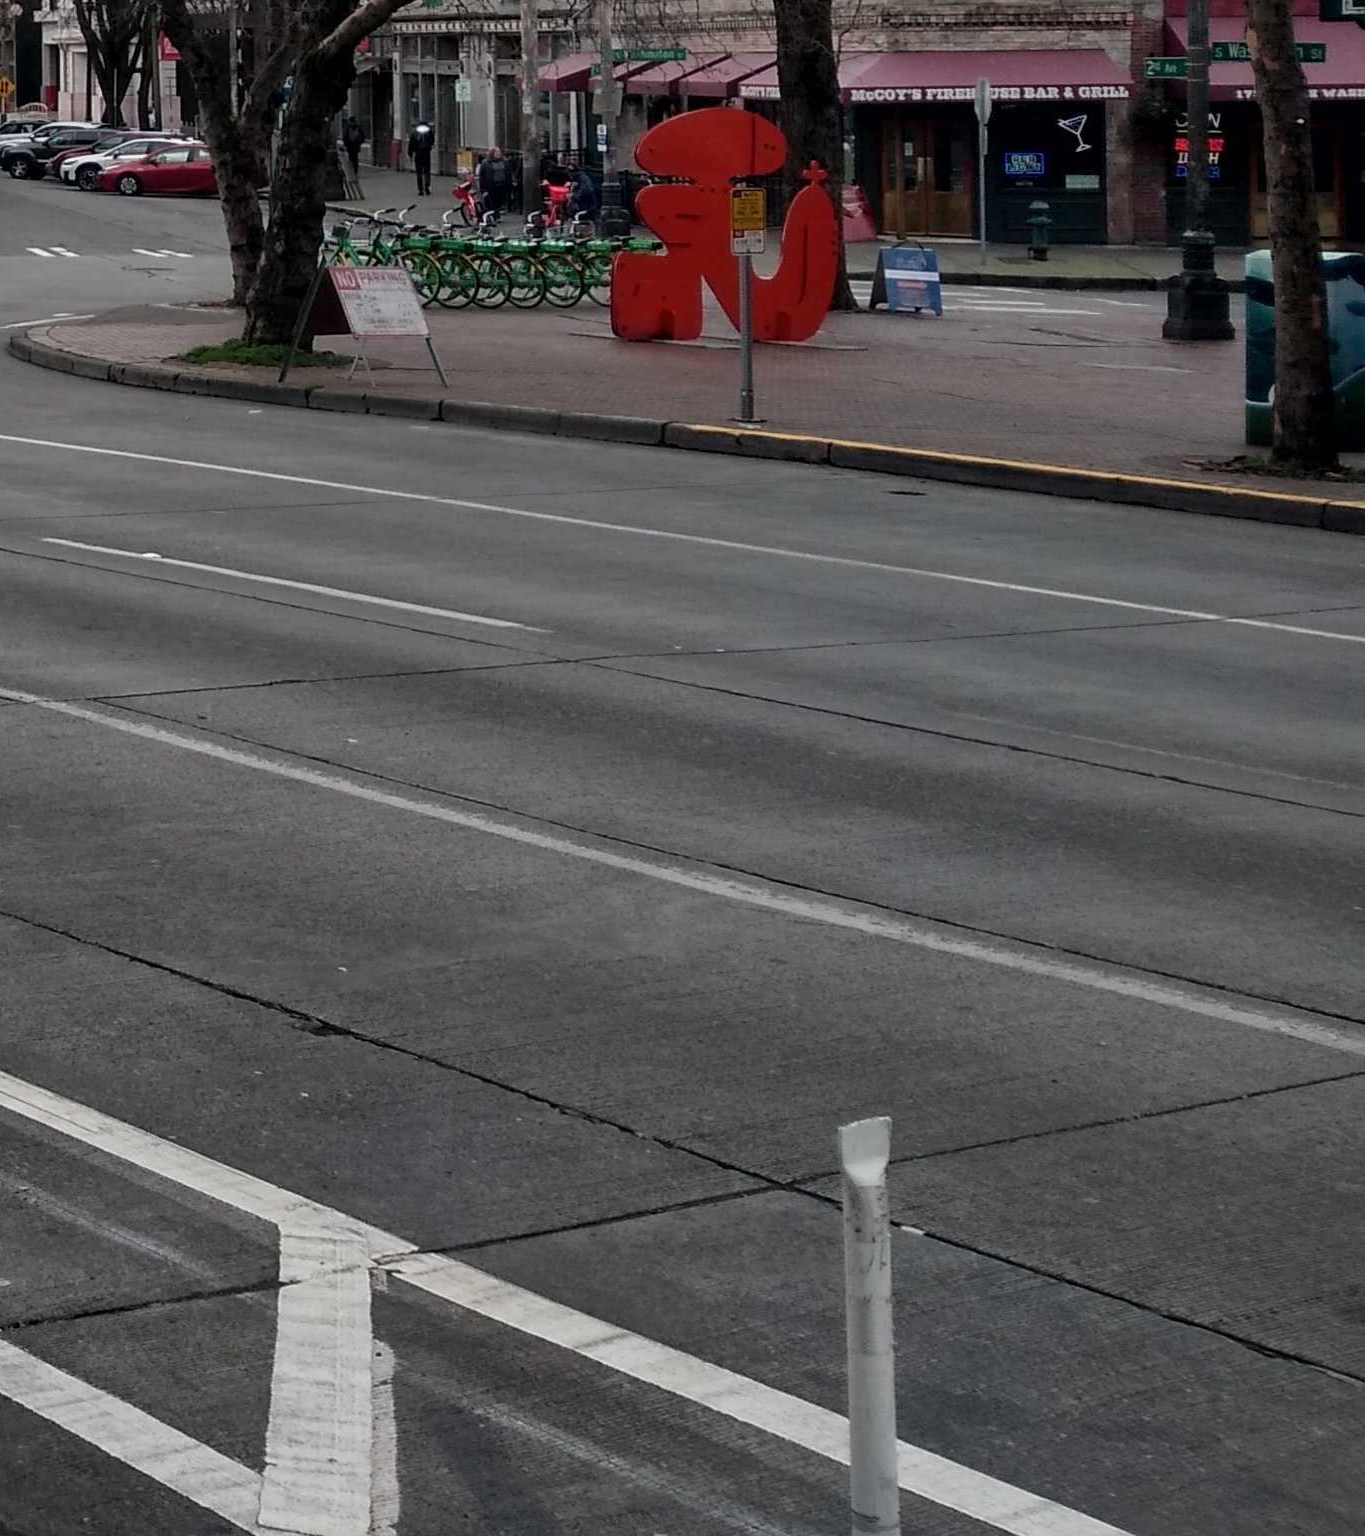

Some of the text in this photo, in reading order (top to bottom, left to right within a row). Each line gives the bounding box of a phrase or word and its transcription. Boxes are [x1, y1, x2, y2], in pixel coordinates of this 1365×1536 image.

[851, 85, 1130, 101] McCOY'S FIREHUSE BAR & GRILL
[334, 270, 407, 288] NO PARKING
